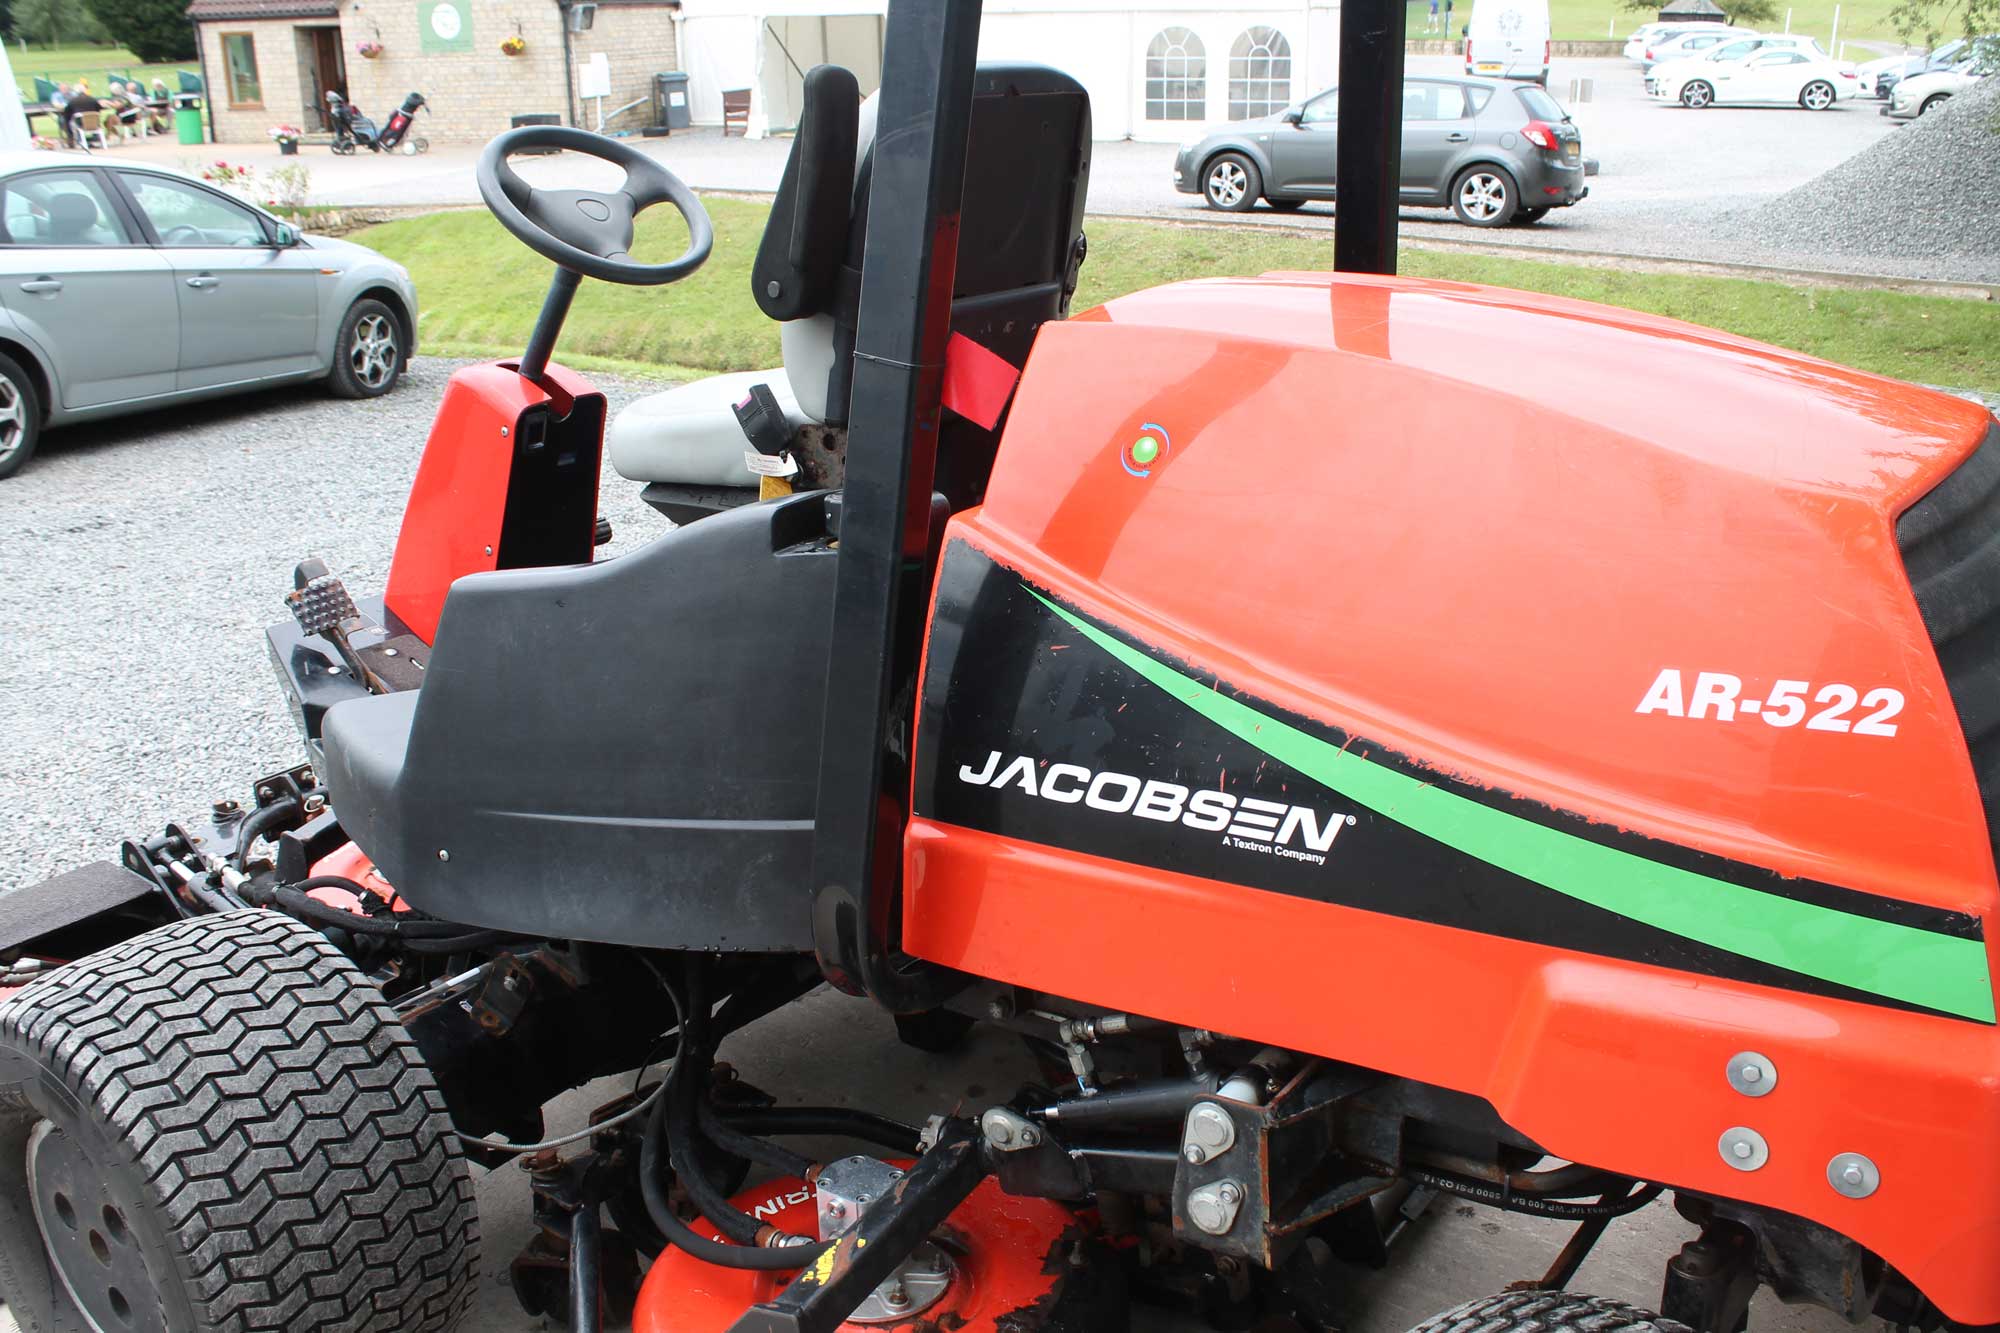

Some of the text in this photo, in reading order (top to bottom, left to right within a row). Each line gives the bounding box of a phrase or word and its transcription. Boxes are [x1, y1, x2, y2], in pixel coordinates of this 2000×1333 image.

[1634, 668, 1905, 737] AR-522
[958, 750, 1347, 852] JACOBSEN
[1222, 836, 1326, 866] A Textron Company
[1456, 1183, 1475, 1194] PSI
